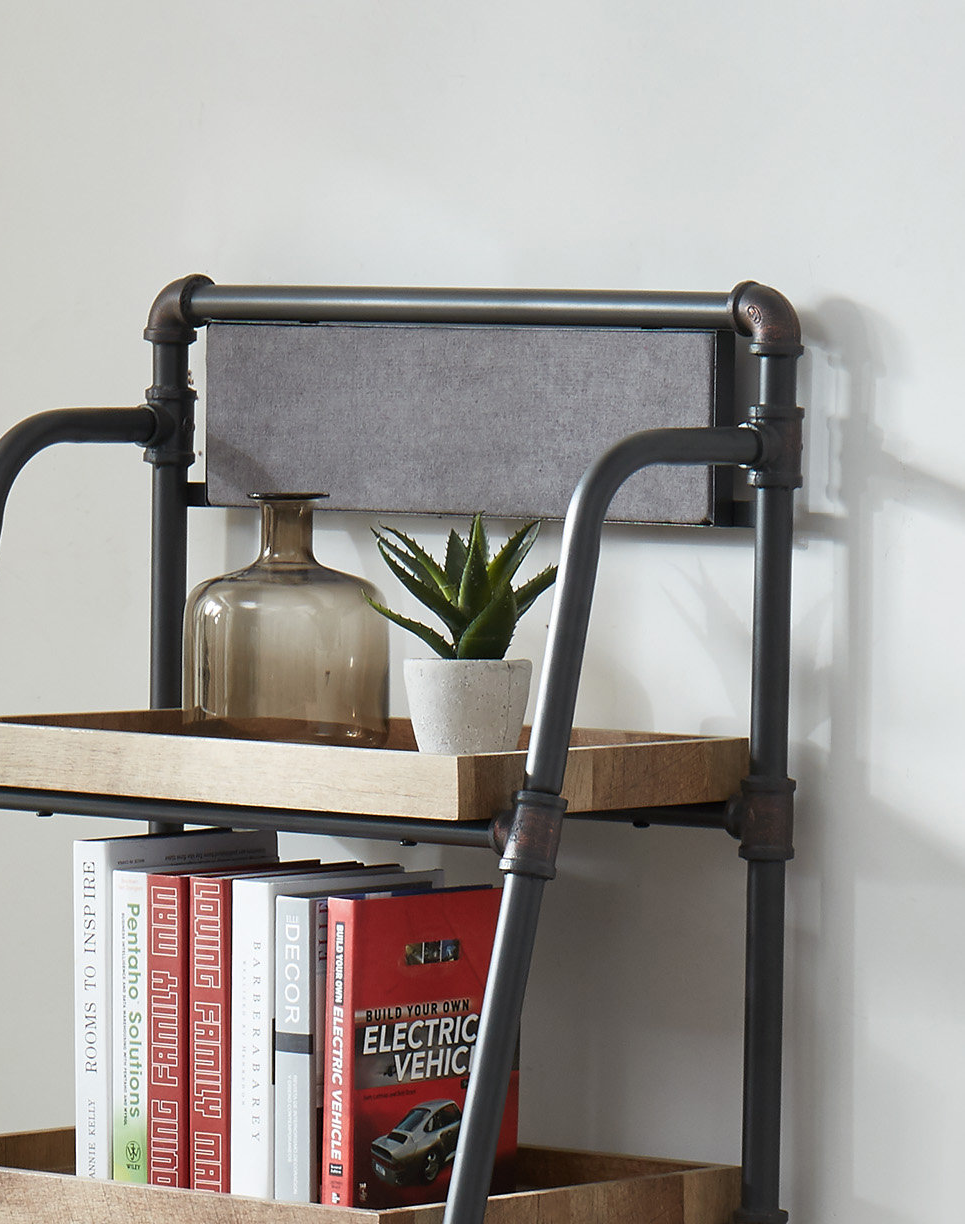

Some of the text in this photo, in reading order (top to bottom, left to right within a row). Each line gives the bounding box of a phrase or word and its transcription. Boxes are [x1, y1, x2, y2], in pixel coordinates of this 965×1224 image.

[84, 860, 98, 1074] ROOMS TO INSPIRE
[126, 903, 141, 998] Pentaho
[194, 882, 221, 989] LOVING
[284, 923, 300, 1024] DECOR
[335, 924, 344, 952] BUILD
[335, 954, 344, 980] YOUR
[335, 980, 343, 1003] OWN
[366, 999, 470, 1022] BUILD YOUR OWN
[128, 1013, 142, 1118] Solutions
[151, 887, 178, 1187] OVING FAMILY MAN
[194, 1000, 221, 1119] FAMILY
[331, 1006, 344, 1086] ELECTRIC
[362, 1013, 480, 1055] ELECTRIC
[393, 1044, 475, 1082] VEHIC
[87, 1098, 97, 1178] ANNIE KELLY
[330, 1090, 342, 1160] VEHICLE
